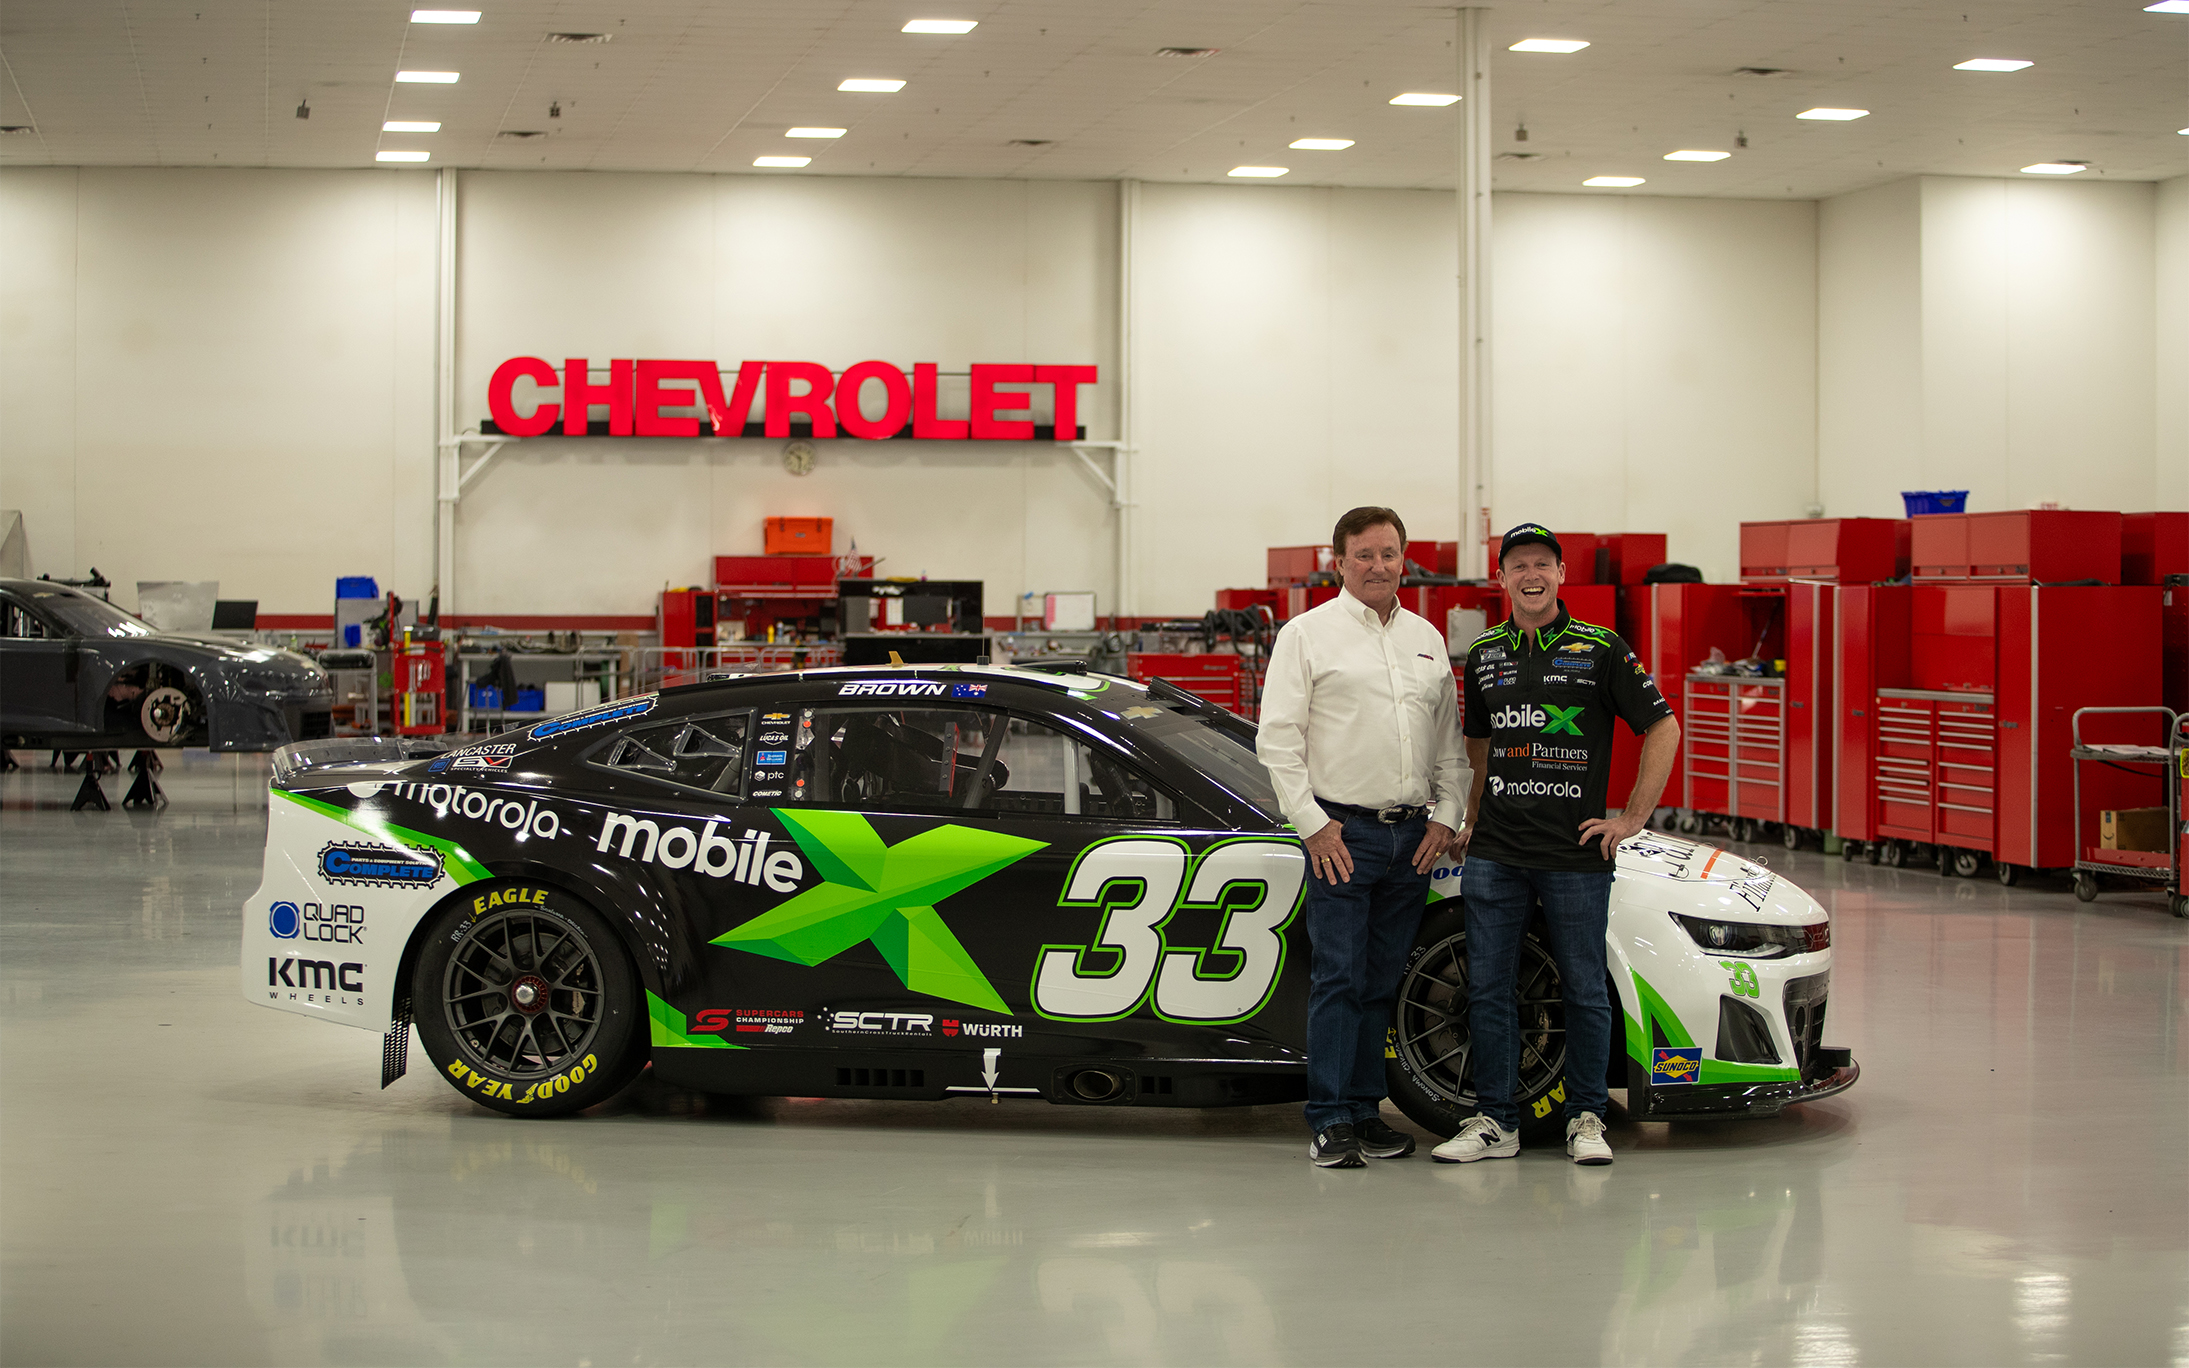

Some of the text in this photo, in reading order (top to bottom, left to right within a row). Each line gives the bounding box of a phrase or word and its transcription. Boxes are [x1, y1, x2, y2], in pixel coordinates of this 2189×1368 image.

[487, 356, 1098, 441] CHEVROLET
[838, 684, 947, 696] BROWN
[779, 734, 789, 742] OIL
[441, 743, 517, 760] LANCASTER
[1507, 742, 1530, 758] and
[1532, 742, 1588, 760] Partners
[1532, 760, 1588, 772] Financial Services
[767, 771, 785, 781] ptc
[1506, 779, 1582, 798] motorola
[394, 781, 560, 841] motorola
[473, 888, 549, 916] EAGLE
[303, 902, 365, 924] QUAD
[303, 922, 364, 945] LOCK
[1030, 835, 1307, 1026] 33
[1718, 961, 1760, 998] 33
[269, 991, 364, 1006] WHEELS
[736, 1009, 804, 1018] SUPERCARS
[736, 1016, 805, 1025] CHAMPIONSHIP
[832, 1011, 934, 1031] SCTR
[764, 1023, 794, 1034] Repco
[1655, 1060, 1700, 1074] SUNOCO
[448, 1053, 598, 1100] GOOD YEAR
